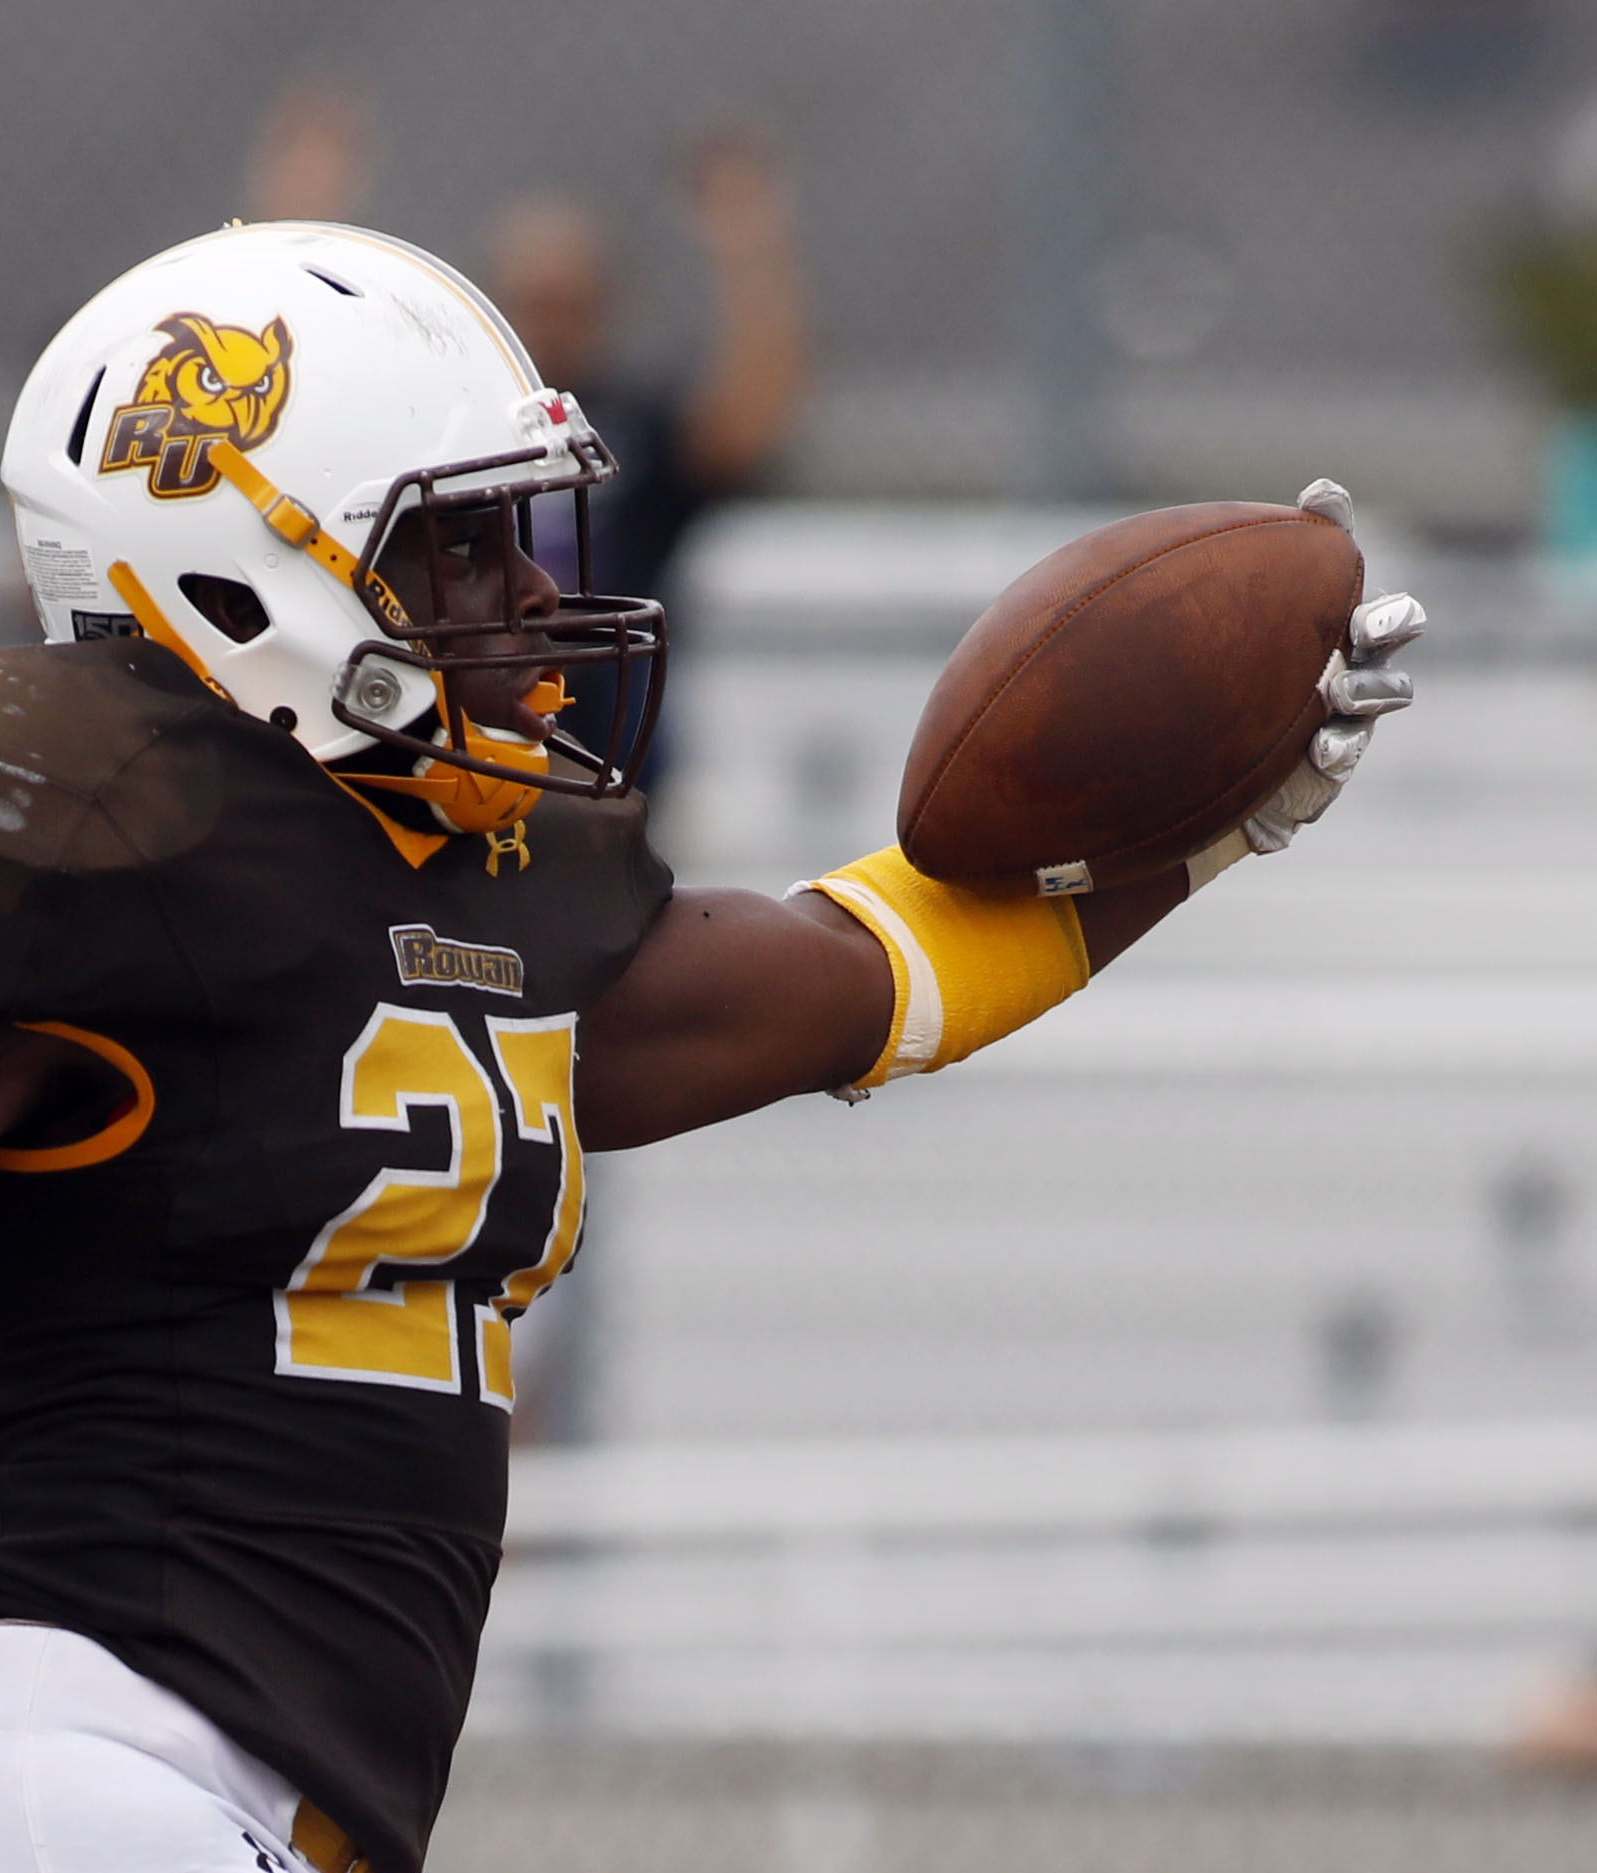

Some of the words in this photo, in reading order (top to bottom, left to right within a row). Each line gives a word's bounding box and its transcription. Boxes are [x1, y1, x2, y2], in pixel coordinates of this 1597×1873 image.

[99, 402, 228, 499] RU
[343, 508, 379, 522] Ridde
[391, 927, 523, 994] Rowan
[273, 1002, 586, 1413] 27
